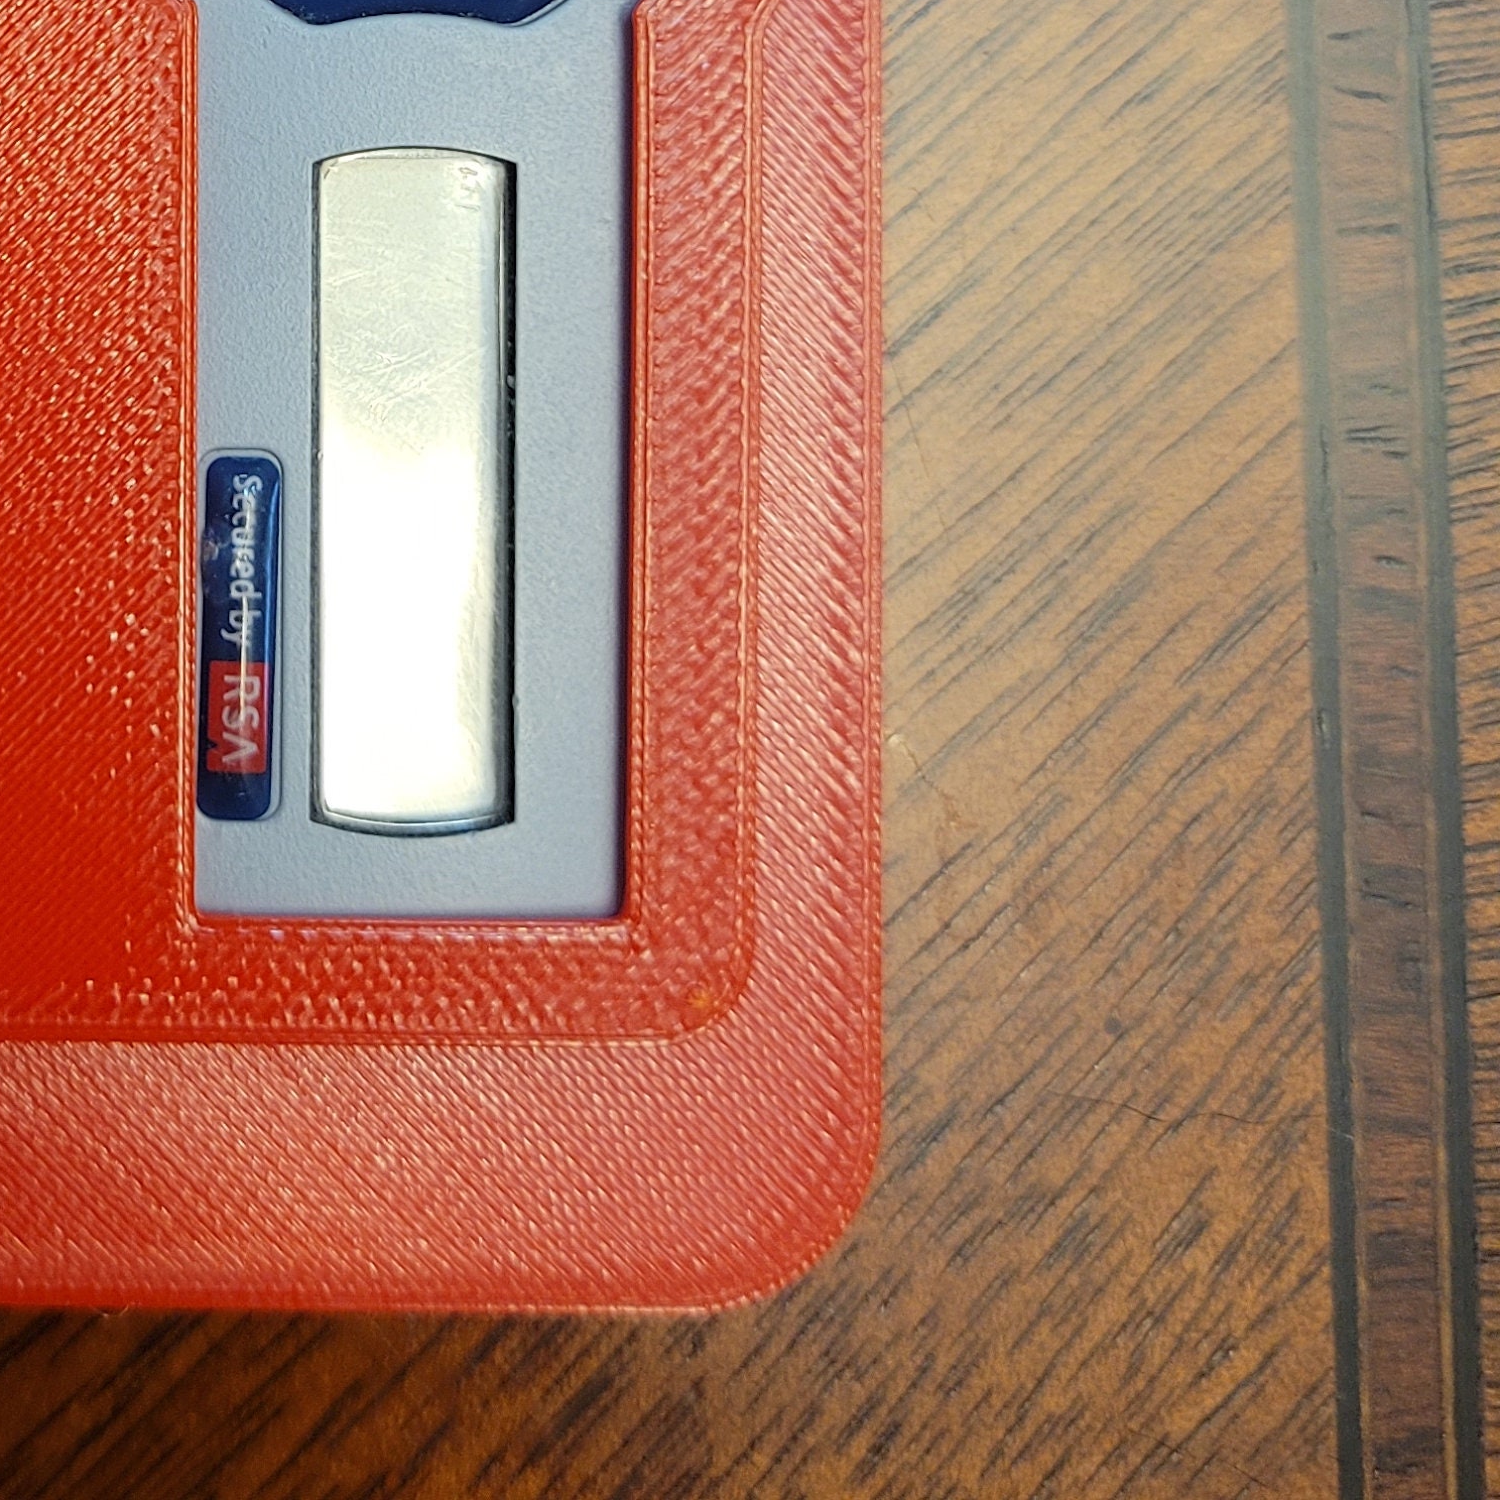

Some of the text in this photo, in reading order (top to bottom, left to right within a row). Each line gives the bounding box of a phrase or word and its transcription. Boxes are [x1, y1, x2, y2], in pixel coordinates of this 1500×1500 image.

[221, 474, 263, 763] Secured by RSA
